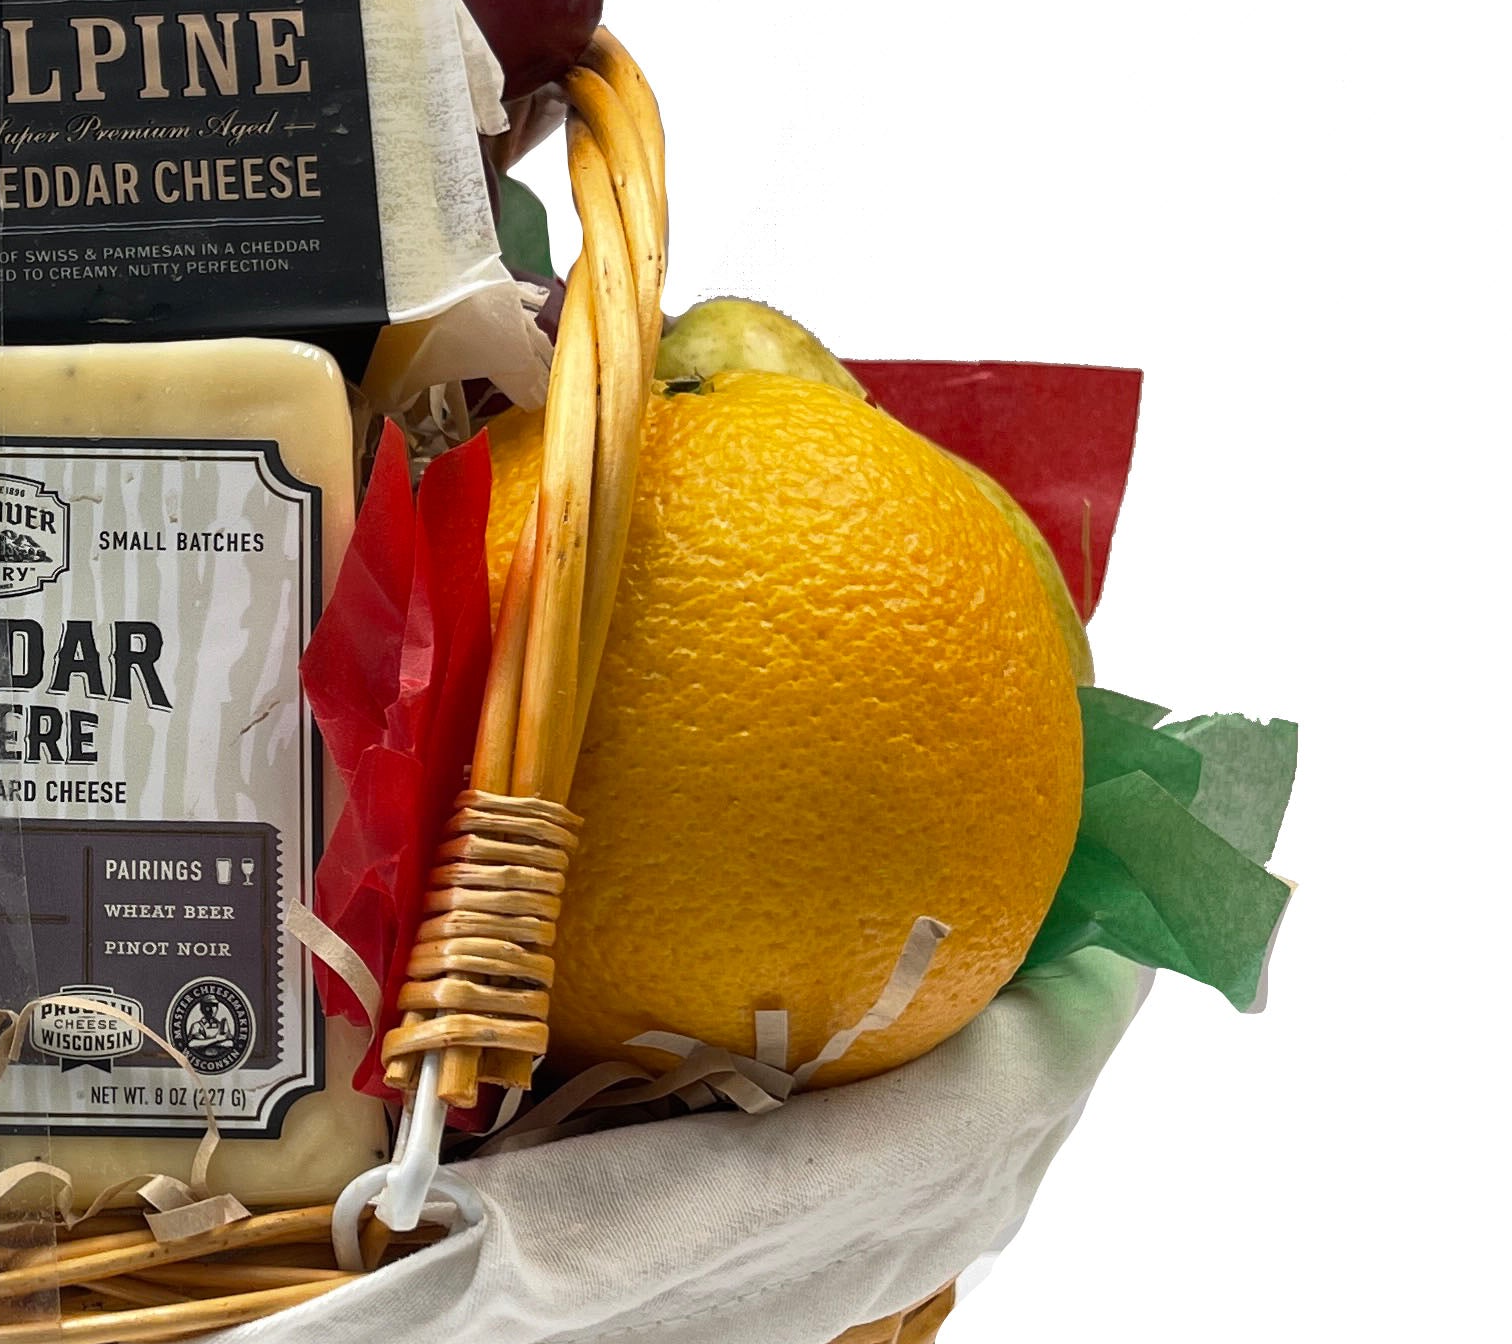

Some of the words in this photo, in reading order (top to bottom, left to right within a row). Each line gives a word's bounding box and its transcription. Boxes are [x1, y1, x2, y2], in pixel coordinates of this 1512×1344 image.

[65, 112, 191, 144] Premium
[198, 108, 278, 146] Aged
[154, 155, 321, 204] CHEESE
[25, 248, 78, 263] SWISS
[84, 247, 97, 261] &
[103, 242, 195, 260] PARMESAN
[201, 241, 219, 256] IN
[224, 241, 235, 255] A
[240, 238, 321, 256] CHEDDAR
[23, 267, 44, 281] TO
[128, 261, 180, 278] NUTTY
[99, 531, 166, 551] SMALL
[177, 532, 264, 552] BATCHES
[46, 780, 127, 804] CHEESE
[105, 859, 202, 881] PAIRINGS
[104, 904, 176, 919] WHEAT
[184, 905, 235, 920] BEER
[104, 940, 169, 956] PINOT
[177, 942, 232, 956] NOIR
[173, 994, 194, 1039] MASTER
[193, 985, 248, 1040] CHEESEMAKER
[54, 1019, 118, 1030] CHEESE
[41, 1028, 133, 1051] WISCONSIN
[182, 1047, 240, 1071] WISCONSIN
[91, 1086, 118, 1105] NET
[124, 1086, 148, 1105] WT.
[155, 1087, 163, 1105] 8
[170, 1087, 187, 1106] OZ
[231, 1088, 246, 1110] G)
